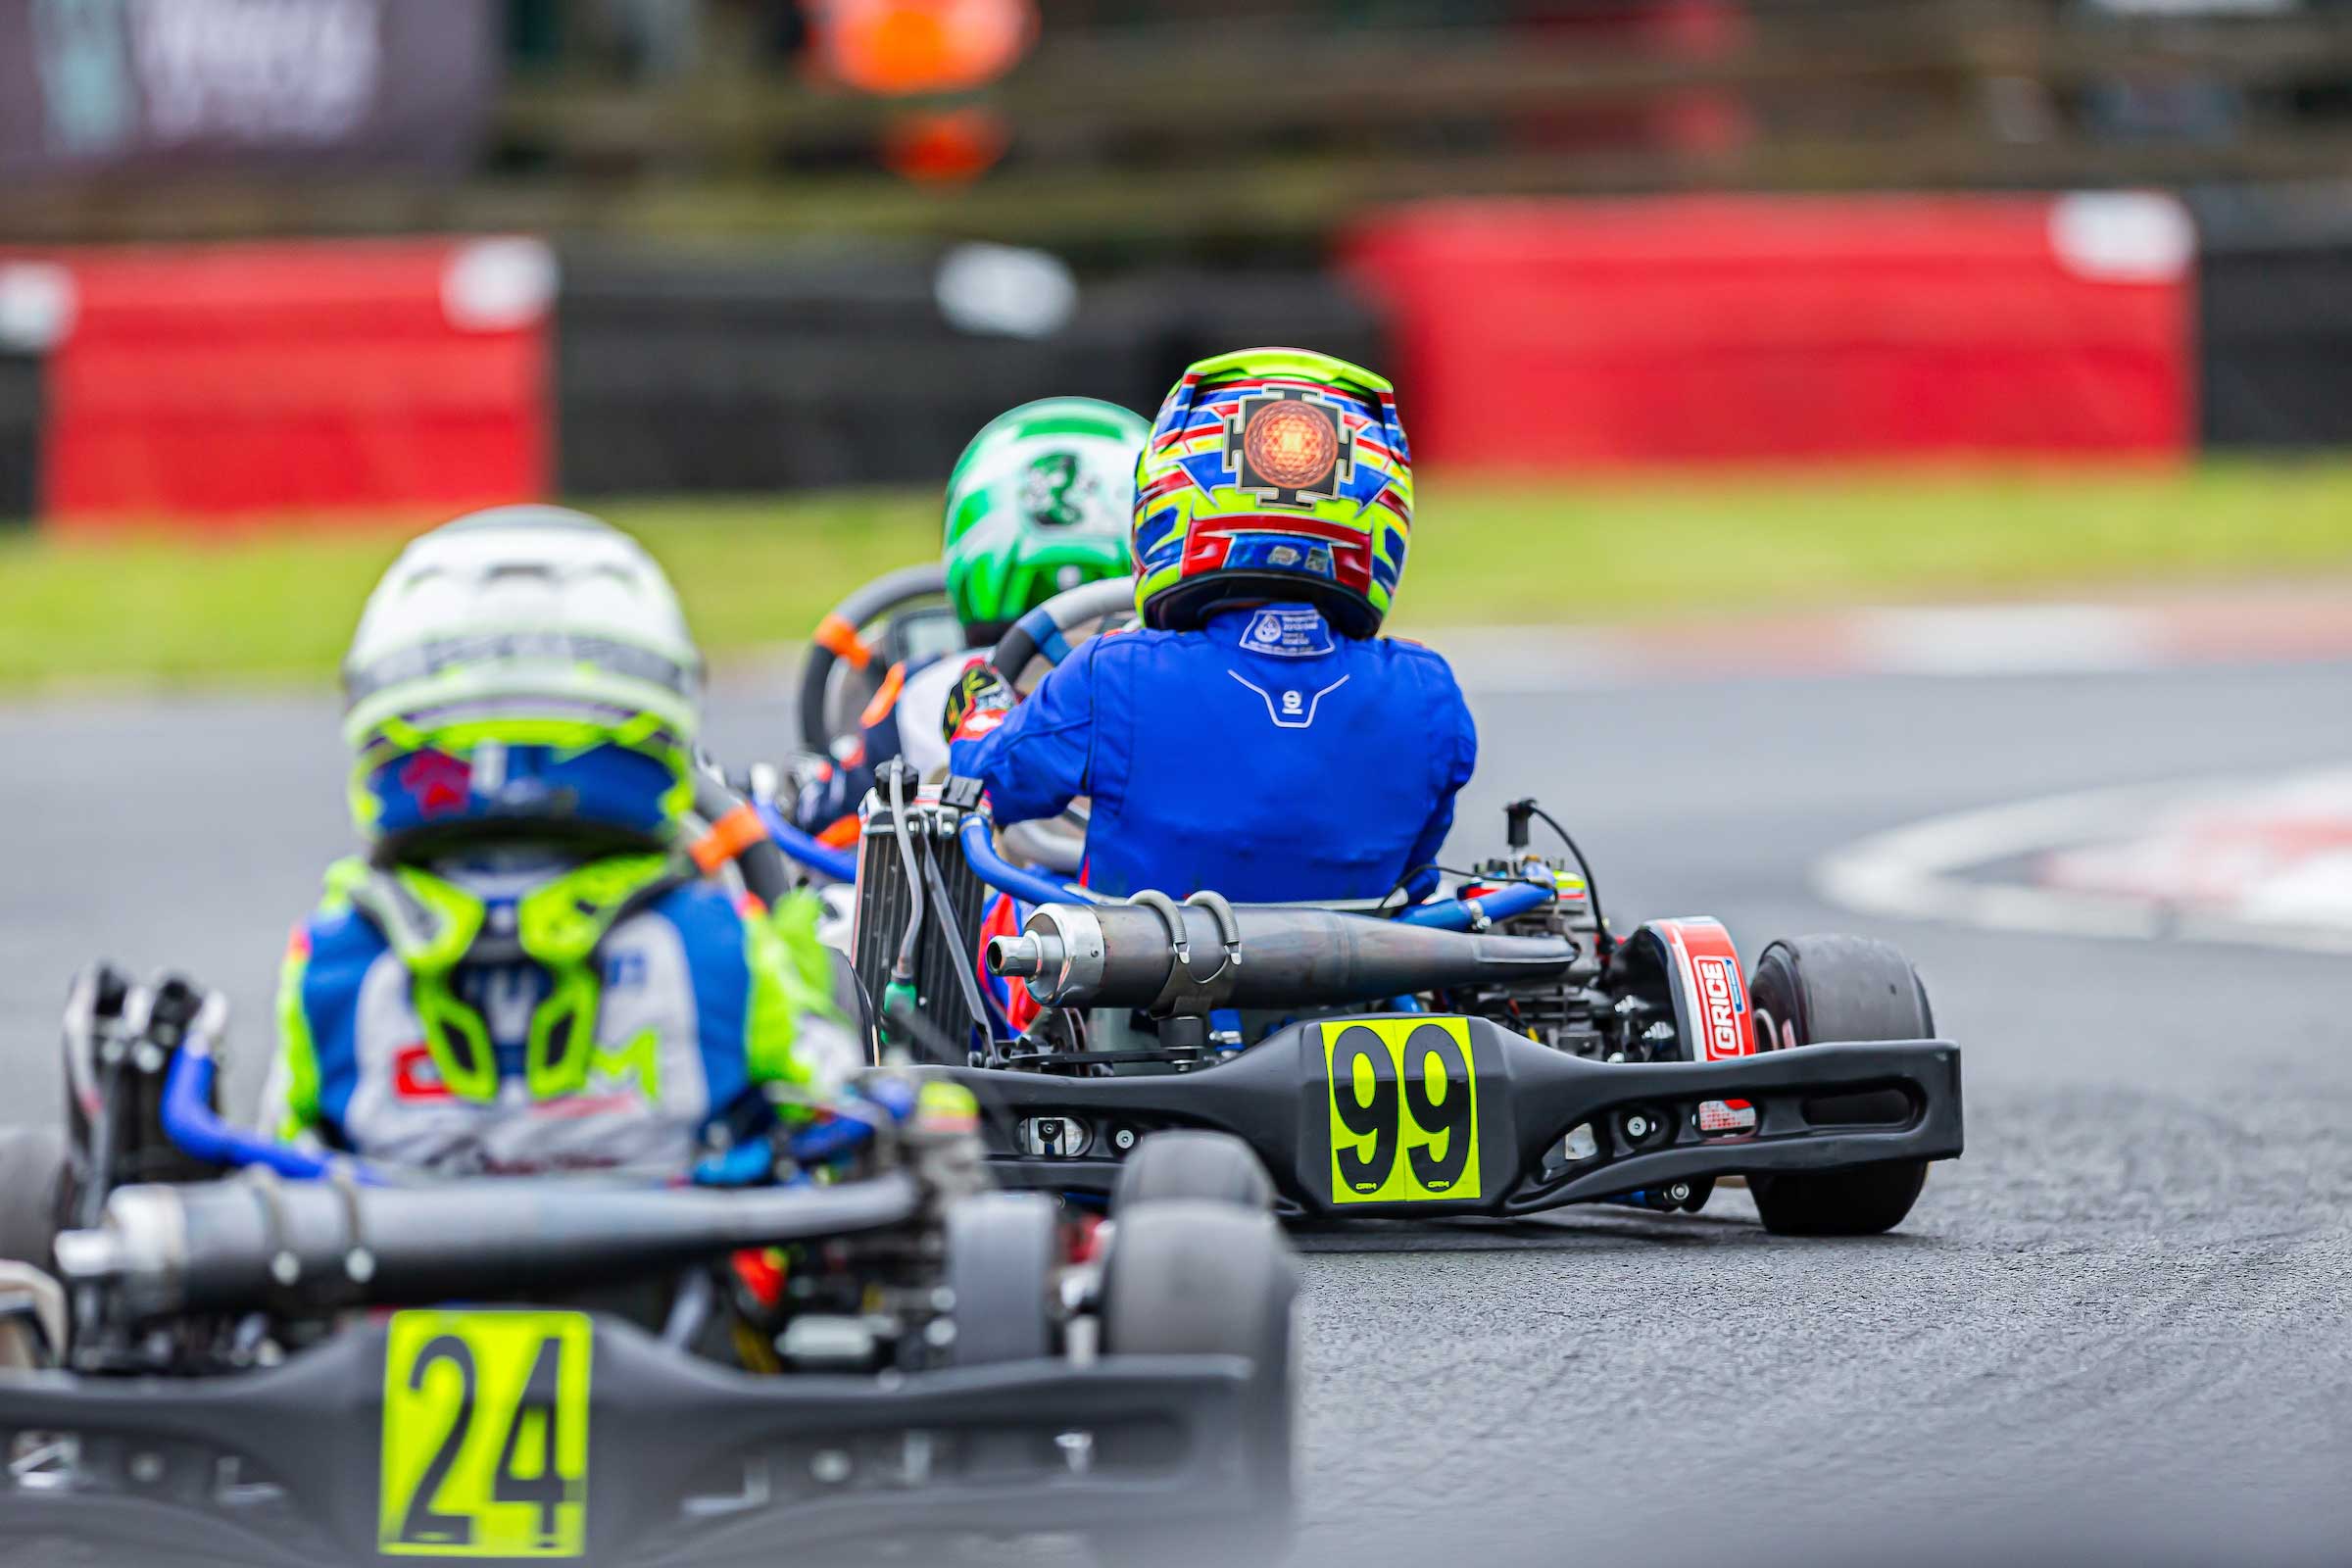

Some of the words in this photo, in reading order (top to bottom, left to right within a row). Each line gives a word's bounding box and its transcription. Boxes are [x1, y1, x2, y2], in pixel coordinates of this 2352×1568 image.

[1701, 962, 1737, 1050] GRICE
[1332, 1023, 1472, 1196] 99
[399, 1334, 580, 1548] 24
